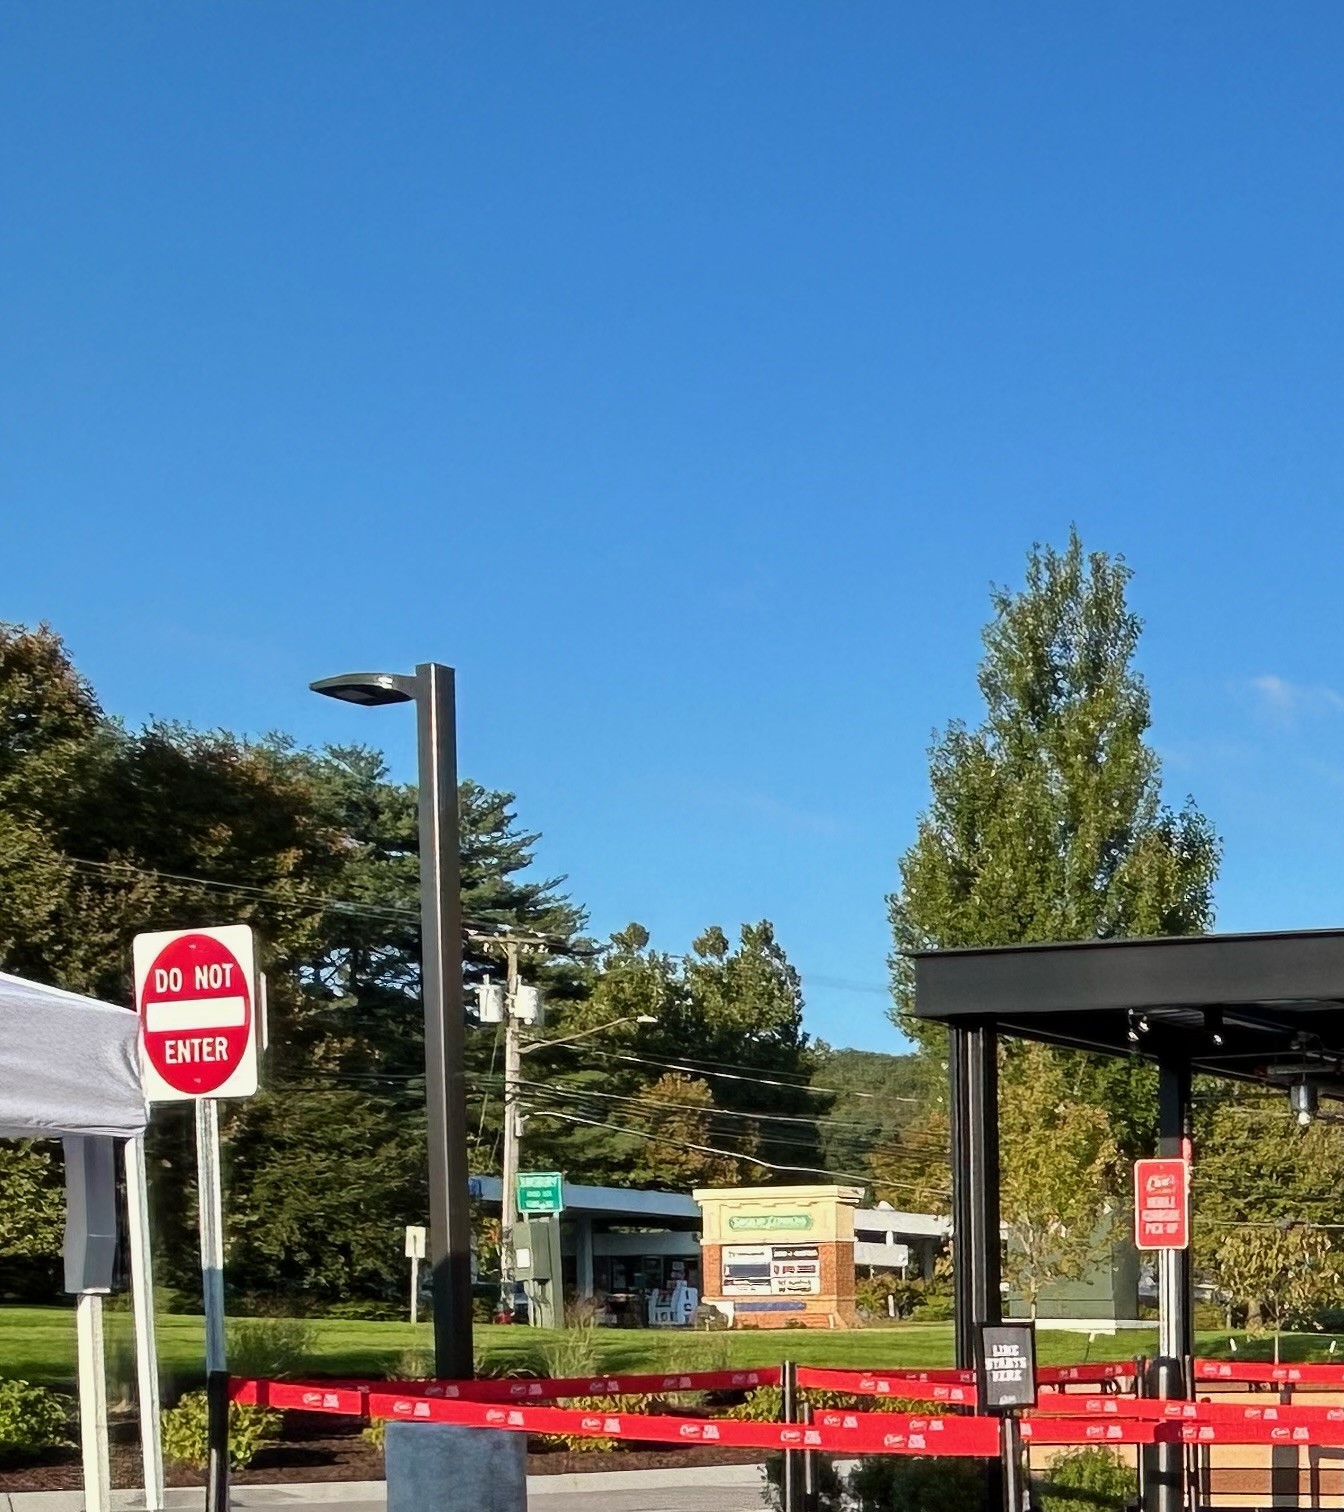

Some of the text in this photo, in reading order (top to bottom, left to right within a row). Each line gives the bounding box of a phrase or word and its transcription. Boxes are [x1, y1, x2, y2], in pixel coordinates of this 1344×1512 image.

[155, 963, 234, 993] DO NOT
[165, 1036, 229, 1064] ENTER
